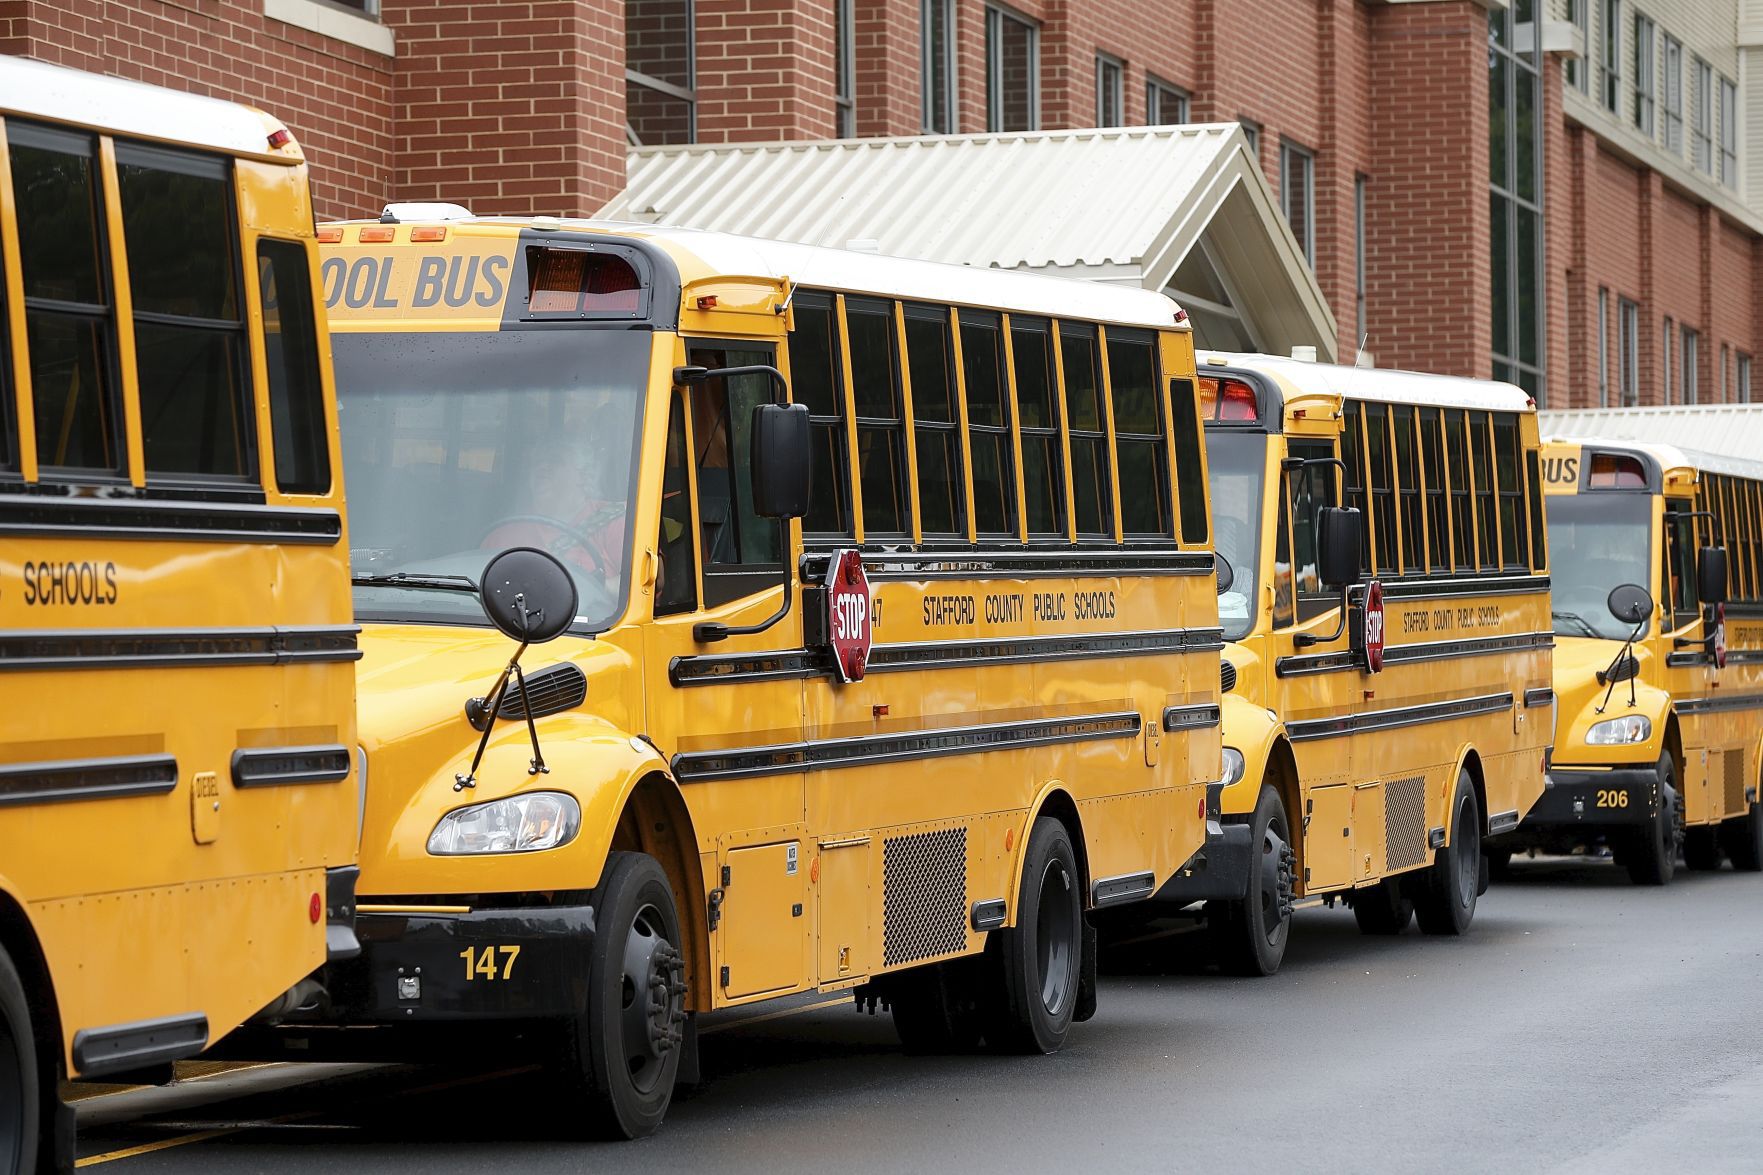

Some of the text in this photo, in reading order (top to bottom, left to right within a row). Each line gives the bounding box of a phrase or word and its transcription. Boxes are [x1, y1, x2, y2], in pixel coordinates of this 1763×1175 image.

[322, 255, 508, 308] OOL BUS
[24, 561, 118, 606] SCHOOLS
[837, 593, 866, 640] STOP
[871, 598, 883, 628] 47
[923, 590, 1115, 626] STAFFORD COUNTY PUBLIC SCHOOLS
[1403, 605, 1500, 633] STAFFORD COUNTY PUBLIC SCHOOLS
[1368, 611, 1382, 644] STOP
[1596, 789, 1629, 808] 206
[459, 945, 521, 981] 147
